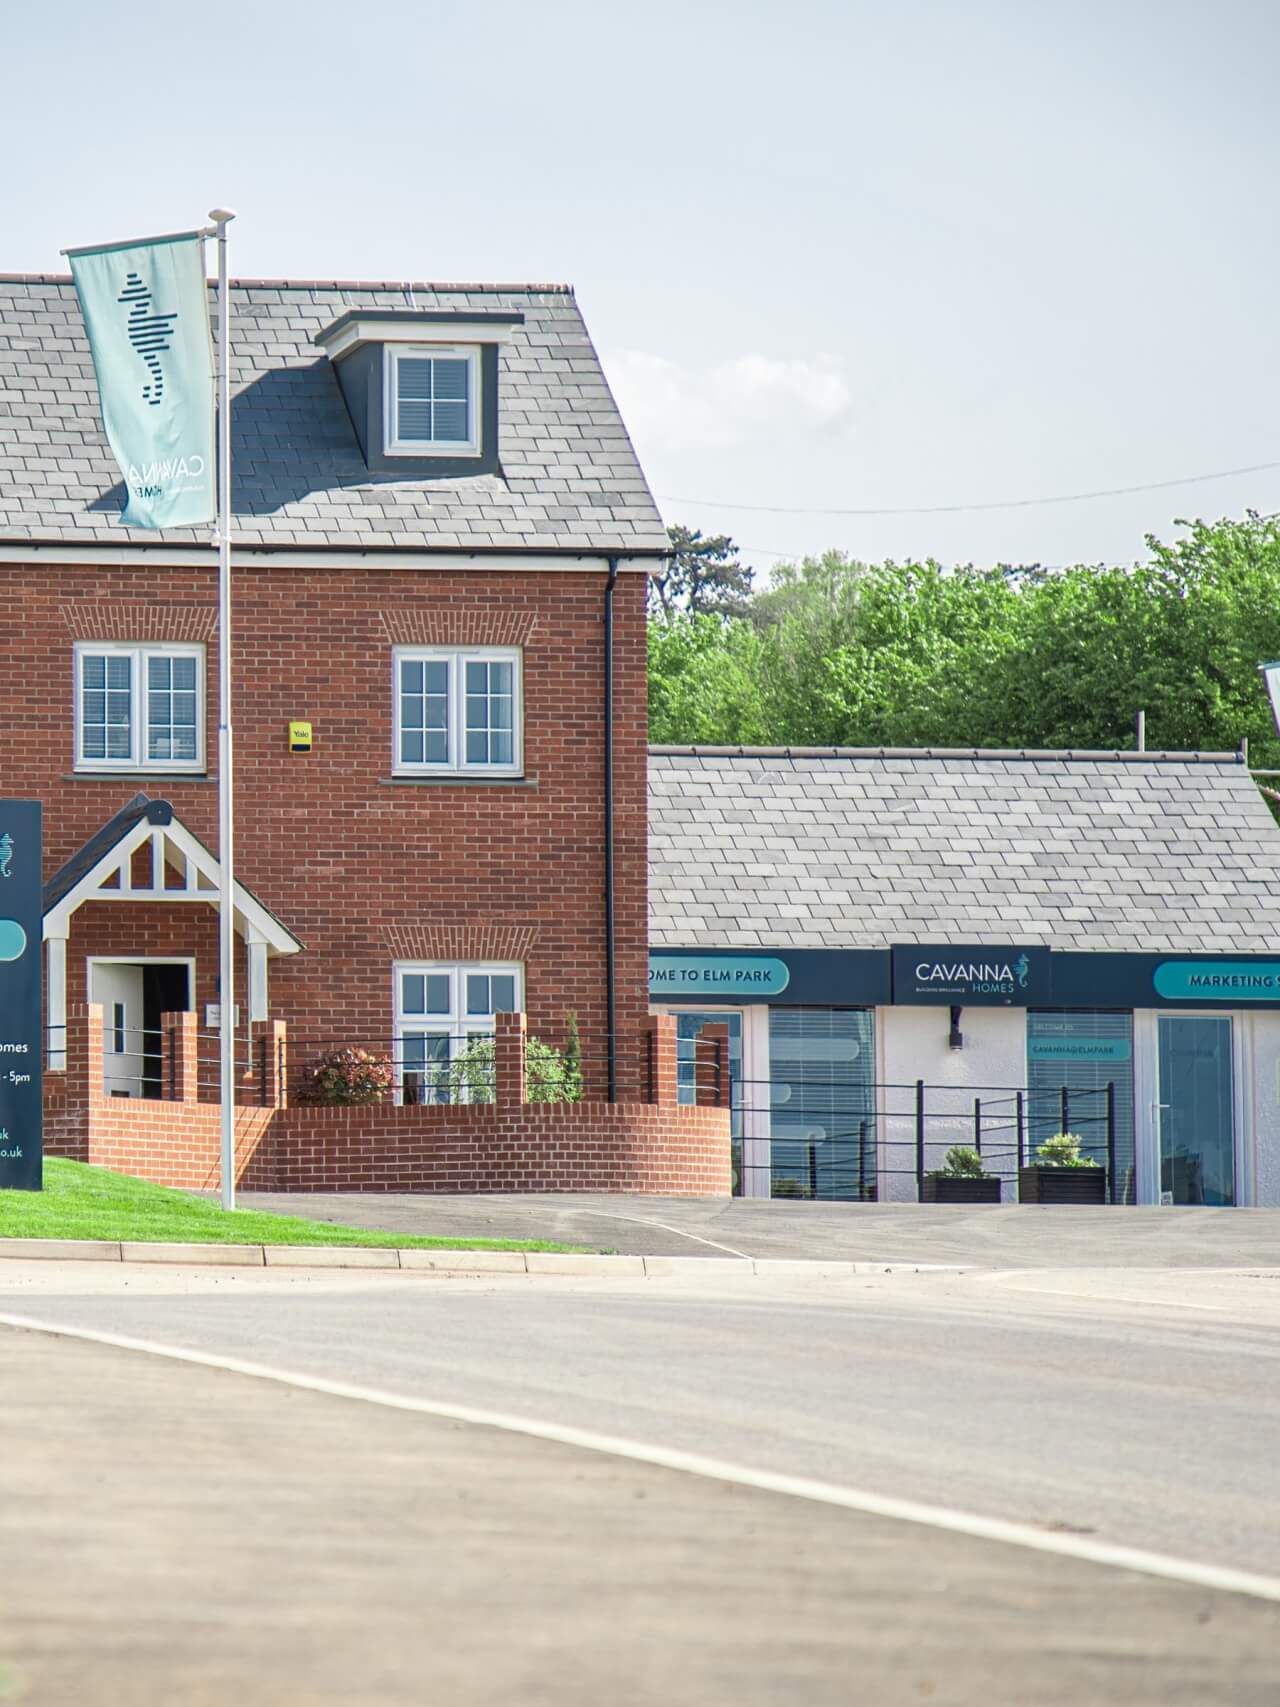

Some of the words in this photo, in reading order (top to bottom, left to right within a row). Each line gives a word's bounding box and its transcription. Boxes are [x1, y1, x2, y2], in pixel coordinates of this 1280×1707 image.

[648, 970, 676, 981] OME
[679, 970, 699, 981] TO
[703, 970, 731, 981] ELM
[735, 970, 772, 982] PARK
[915, 963, 1014, 981] CAVANNA
[1189, 975, 1273, 987] MARKETING
[972, 983, 1014, 993] HOMES
[9, 1071, 30, 1085] 5pm
